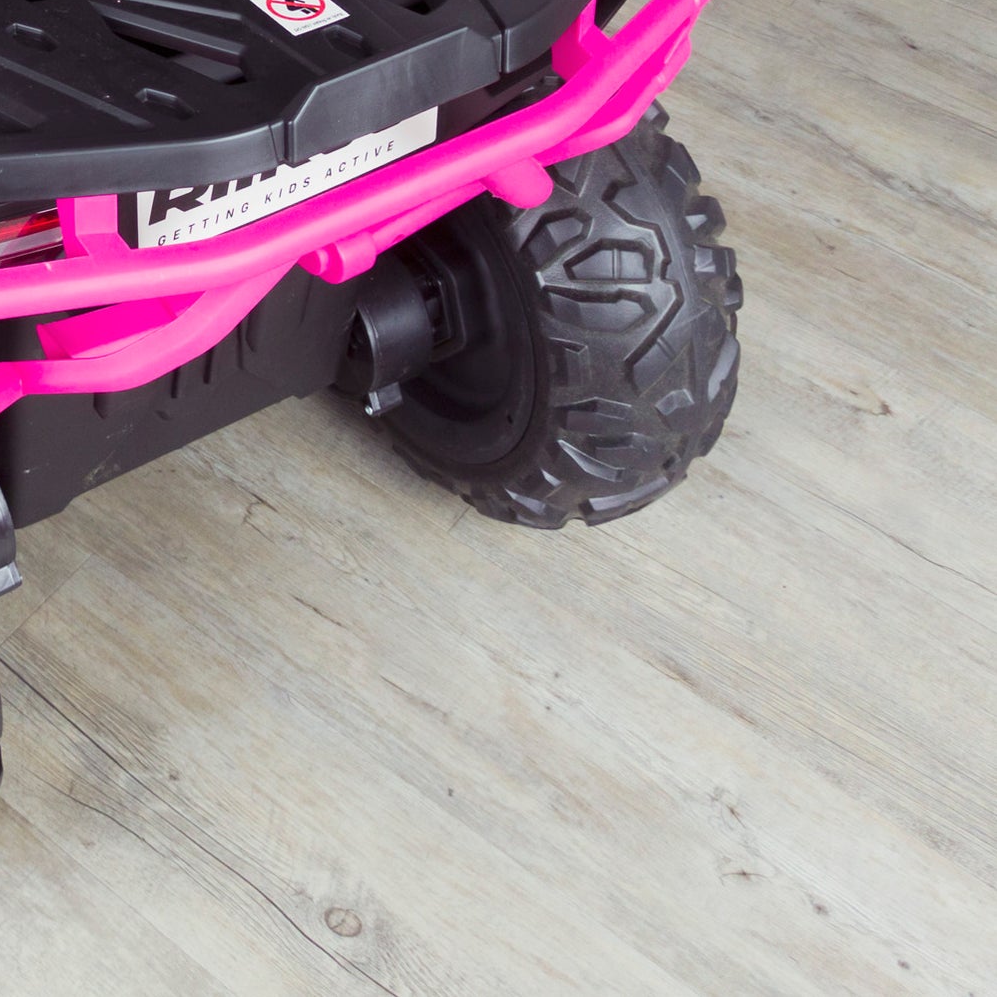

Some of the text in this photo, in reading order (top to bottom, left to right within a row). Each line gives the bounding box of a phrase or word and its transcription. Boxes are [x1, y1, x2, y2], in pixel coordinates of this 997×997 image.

[157, 202, 250, 247] GETTING
[264, 177, 312, 204] KIDS
[324, 140, 395, 179] ACTIVE
